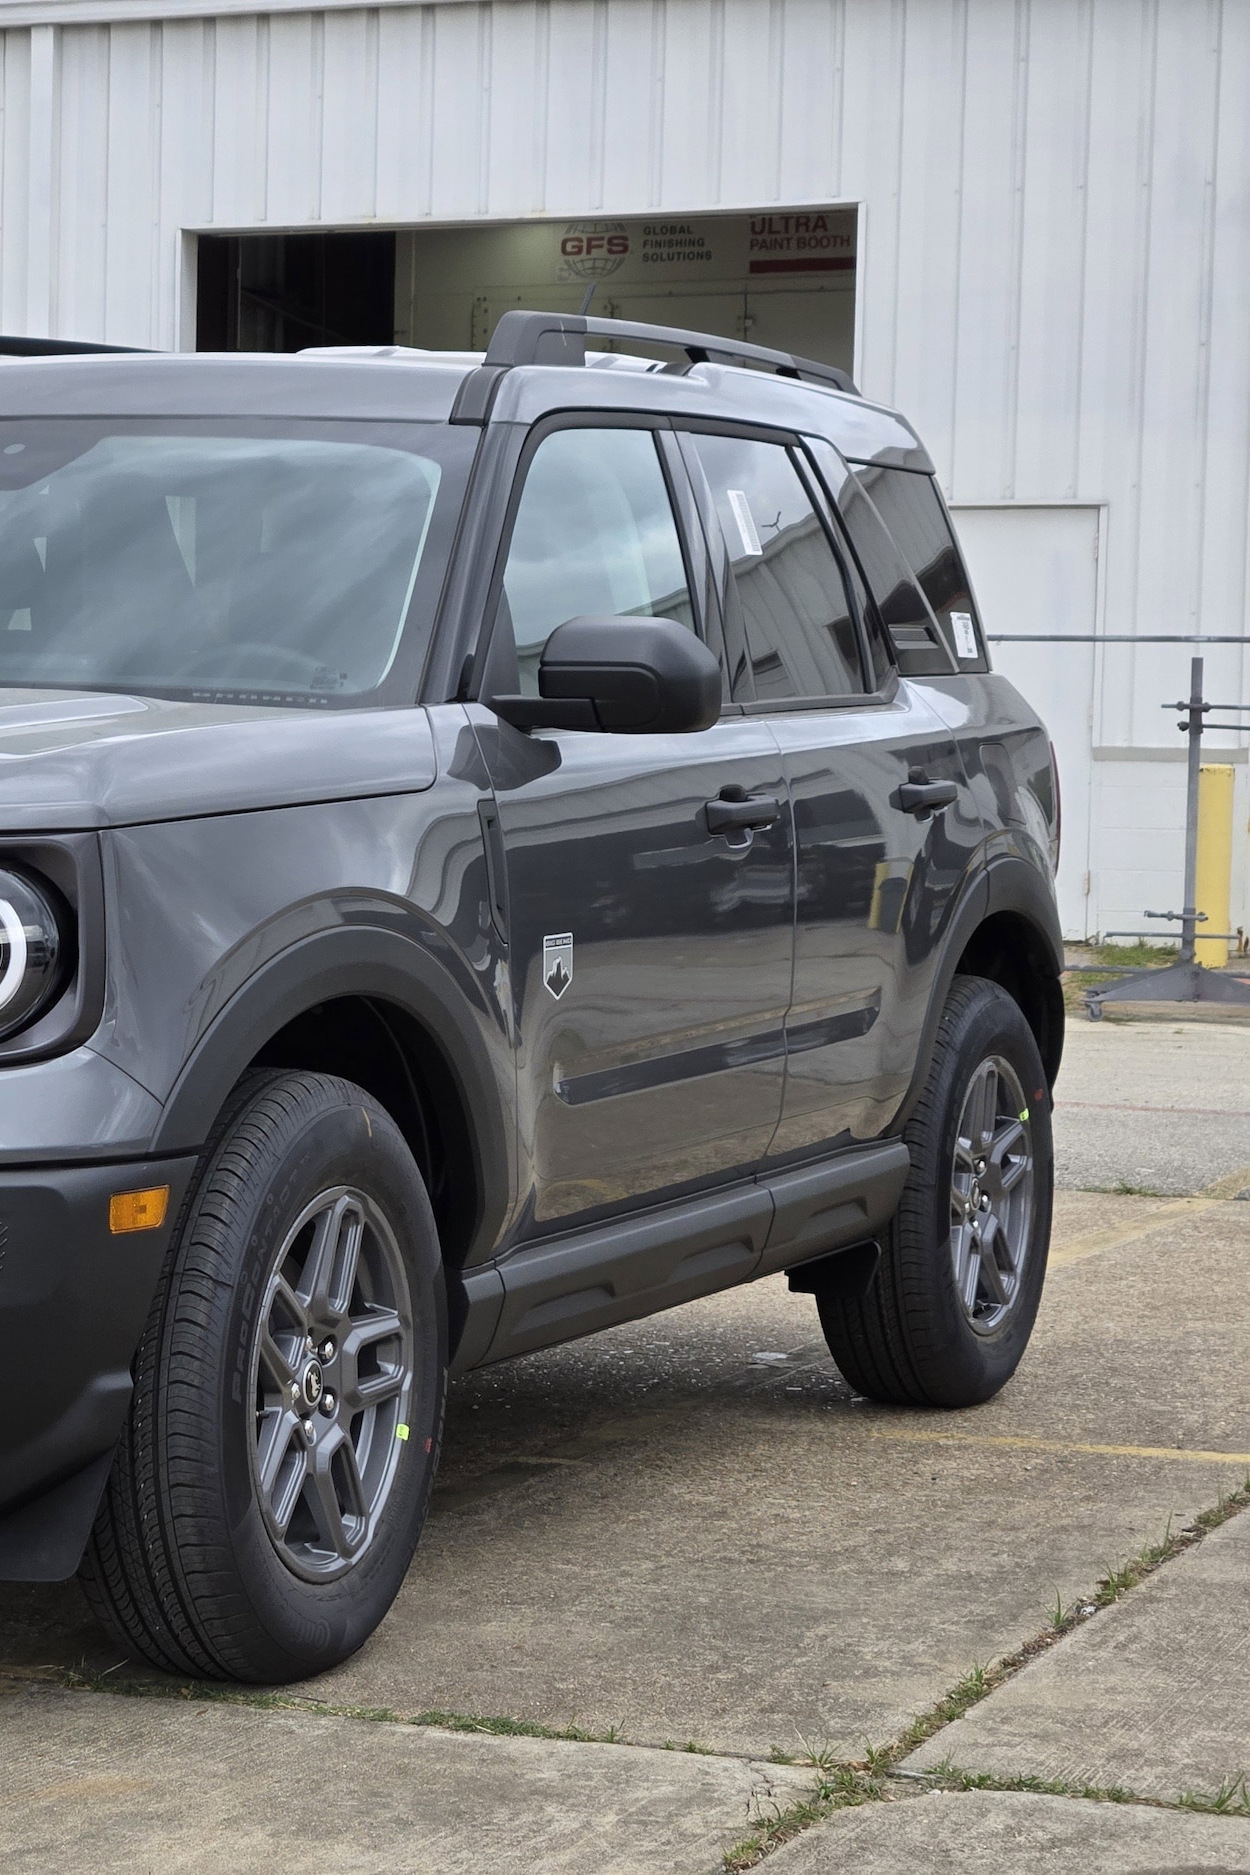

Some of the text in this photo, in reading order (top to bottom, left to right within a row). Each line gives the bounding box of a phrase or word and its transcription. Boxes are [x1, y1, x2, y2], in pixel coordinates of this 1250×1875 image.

[643, 224, 694, 236] GLOBAL
[750, 215, 828, 235] ULTRA
[560, 235, 629, 256] GFS
[642, 237, 706, 249] FINISHING
[750, 234, 851, 251] PAINT BOOTH
[642, 250, 713, 263] SOLUTIONS
